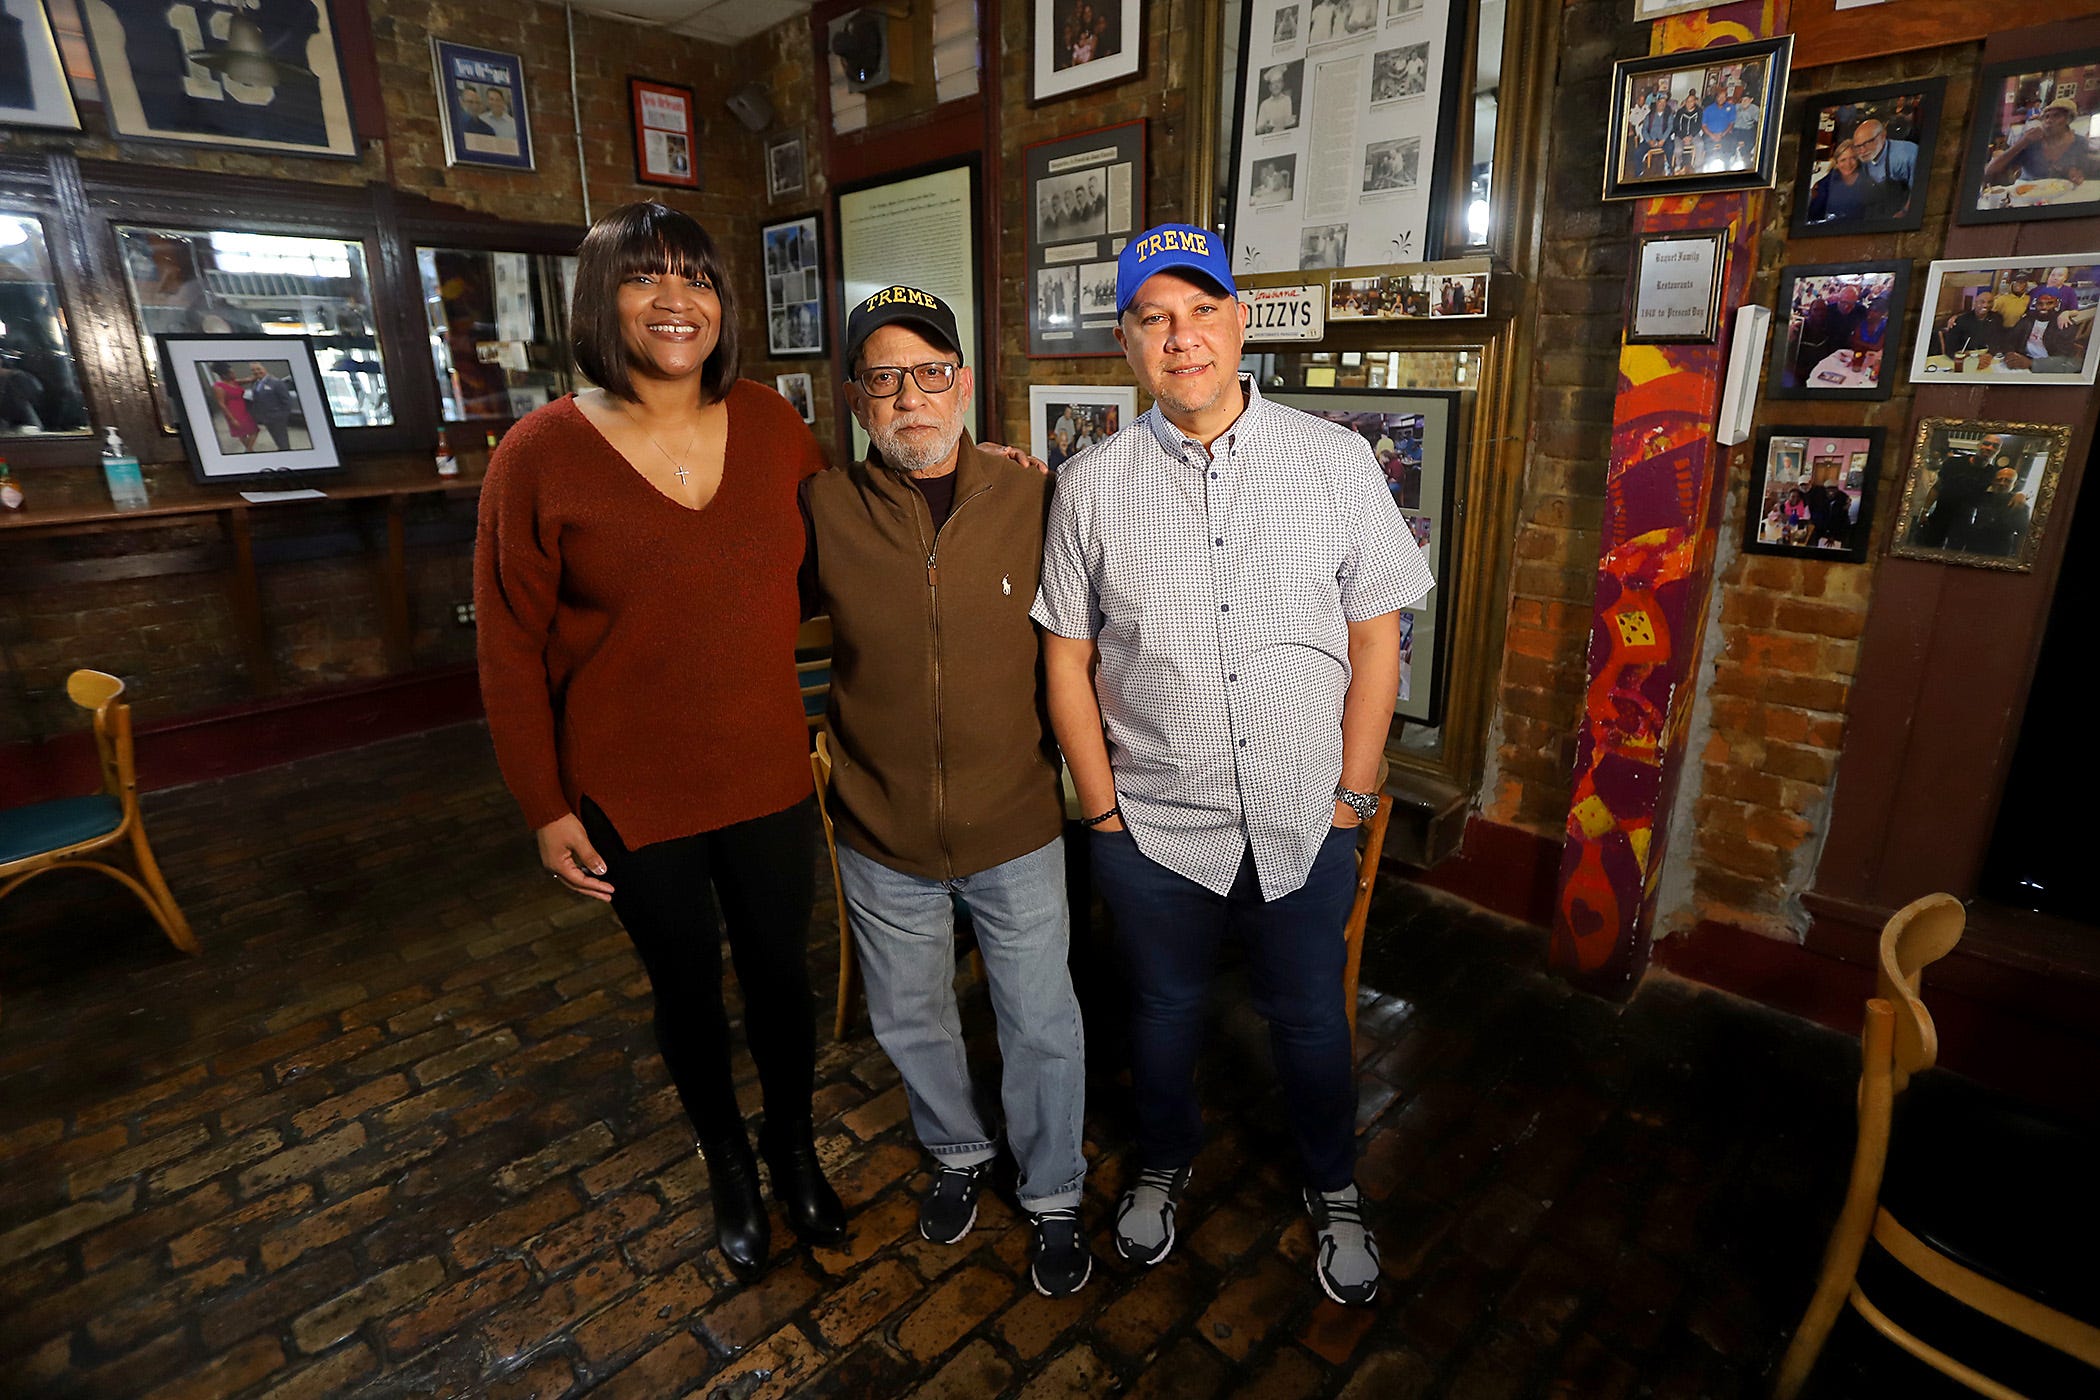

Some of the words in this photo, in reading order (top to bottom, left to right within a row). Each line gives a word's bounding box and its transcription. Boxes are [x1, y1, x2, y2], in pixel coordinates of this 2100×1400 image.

[1136, 230, 1210, 263] TREME
[866, 286, 938, 313] TREME
[1246, 301, 1311, 328] DIZZYS
